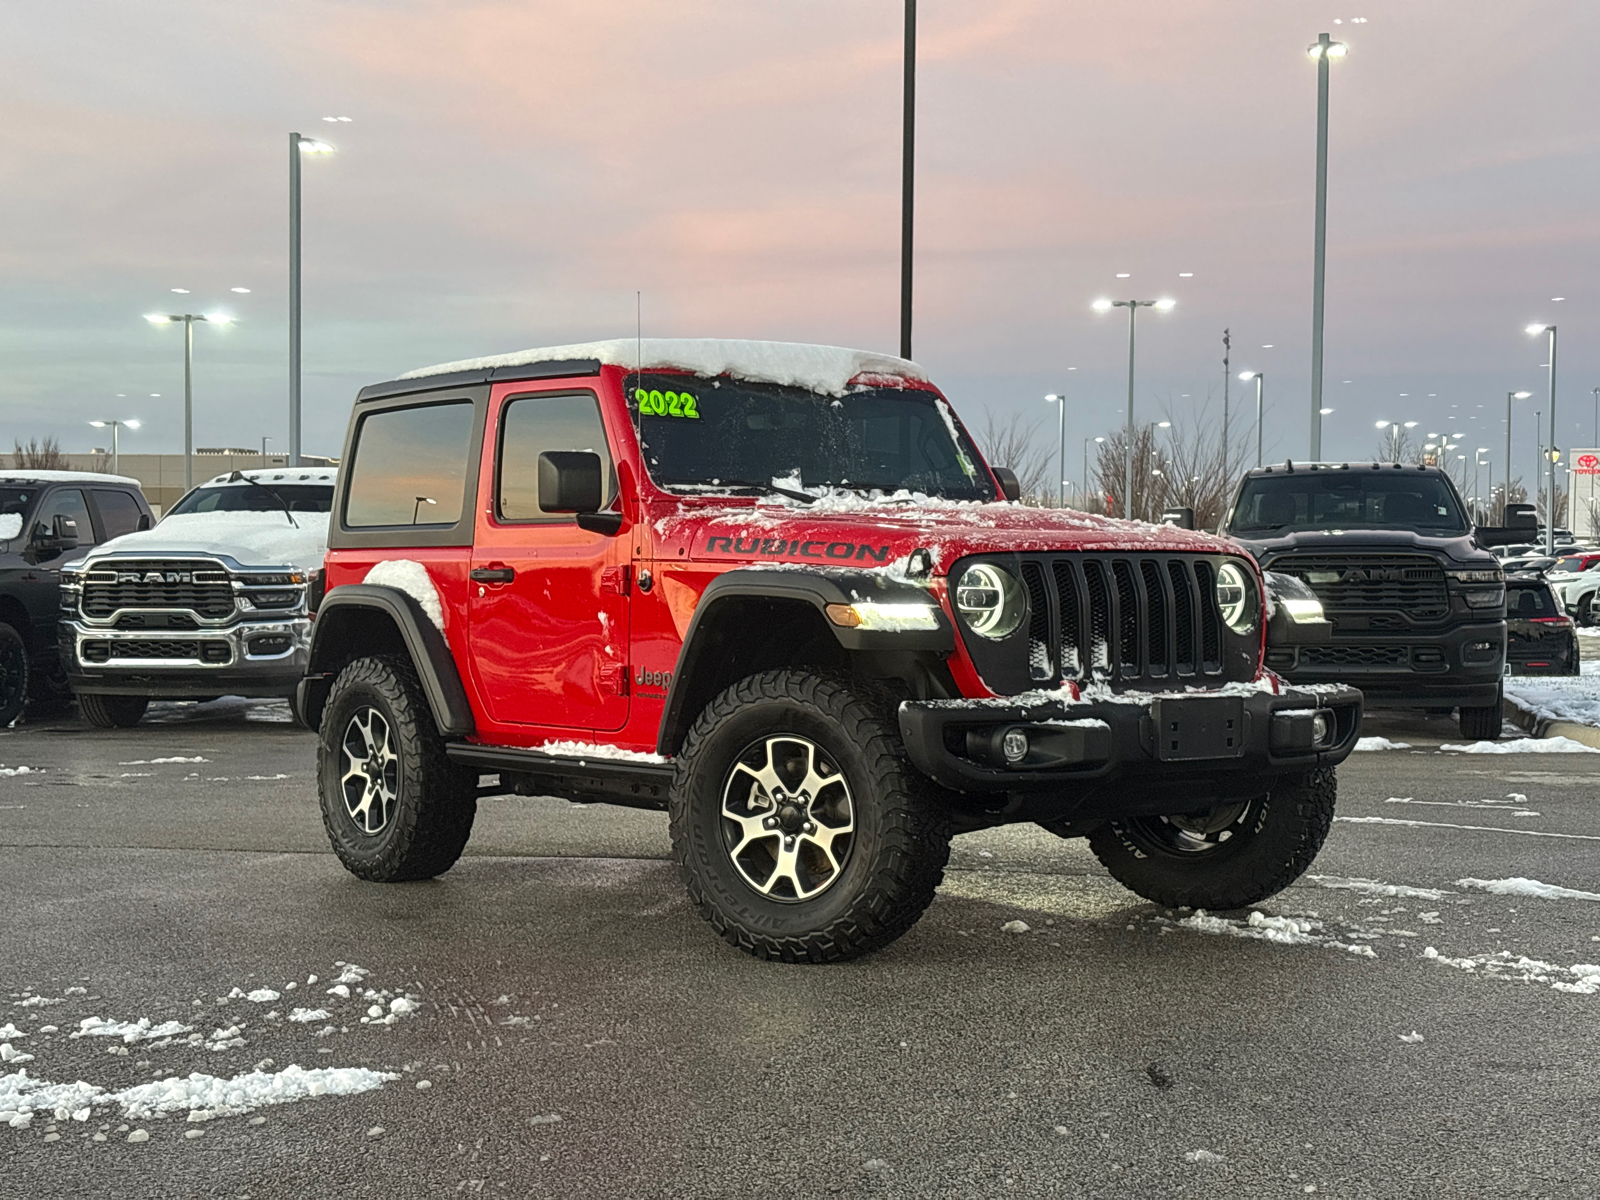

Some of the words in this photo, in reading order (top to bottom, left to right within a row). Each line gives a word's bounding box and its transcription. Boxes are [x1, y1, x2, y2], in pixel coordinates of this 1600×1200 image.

[635, 389, 700, 418] 2022
[706, 536, 890, 562] RUBICON
[119, 572, 191, 583] RAM
[1340, 569, 1401, 581] AM
[635, 665, 671, 691] Jeep
